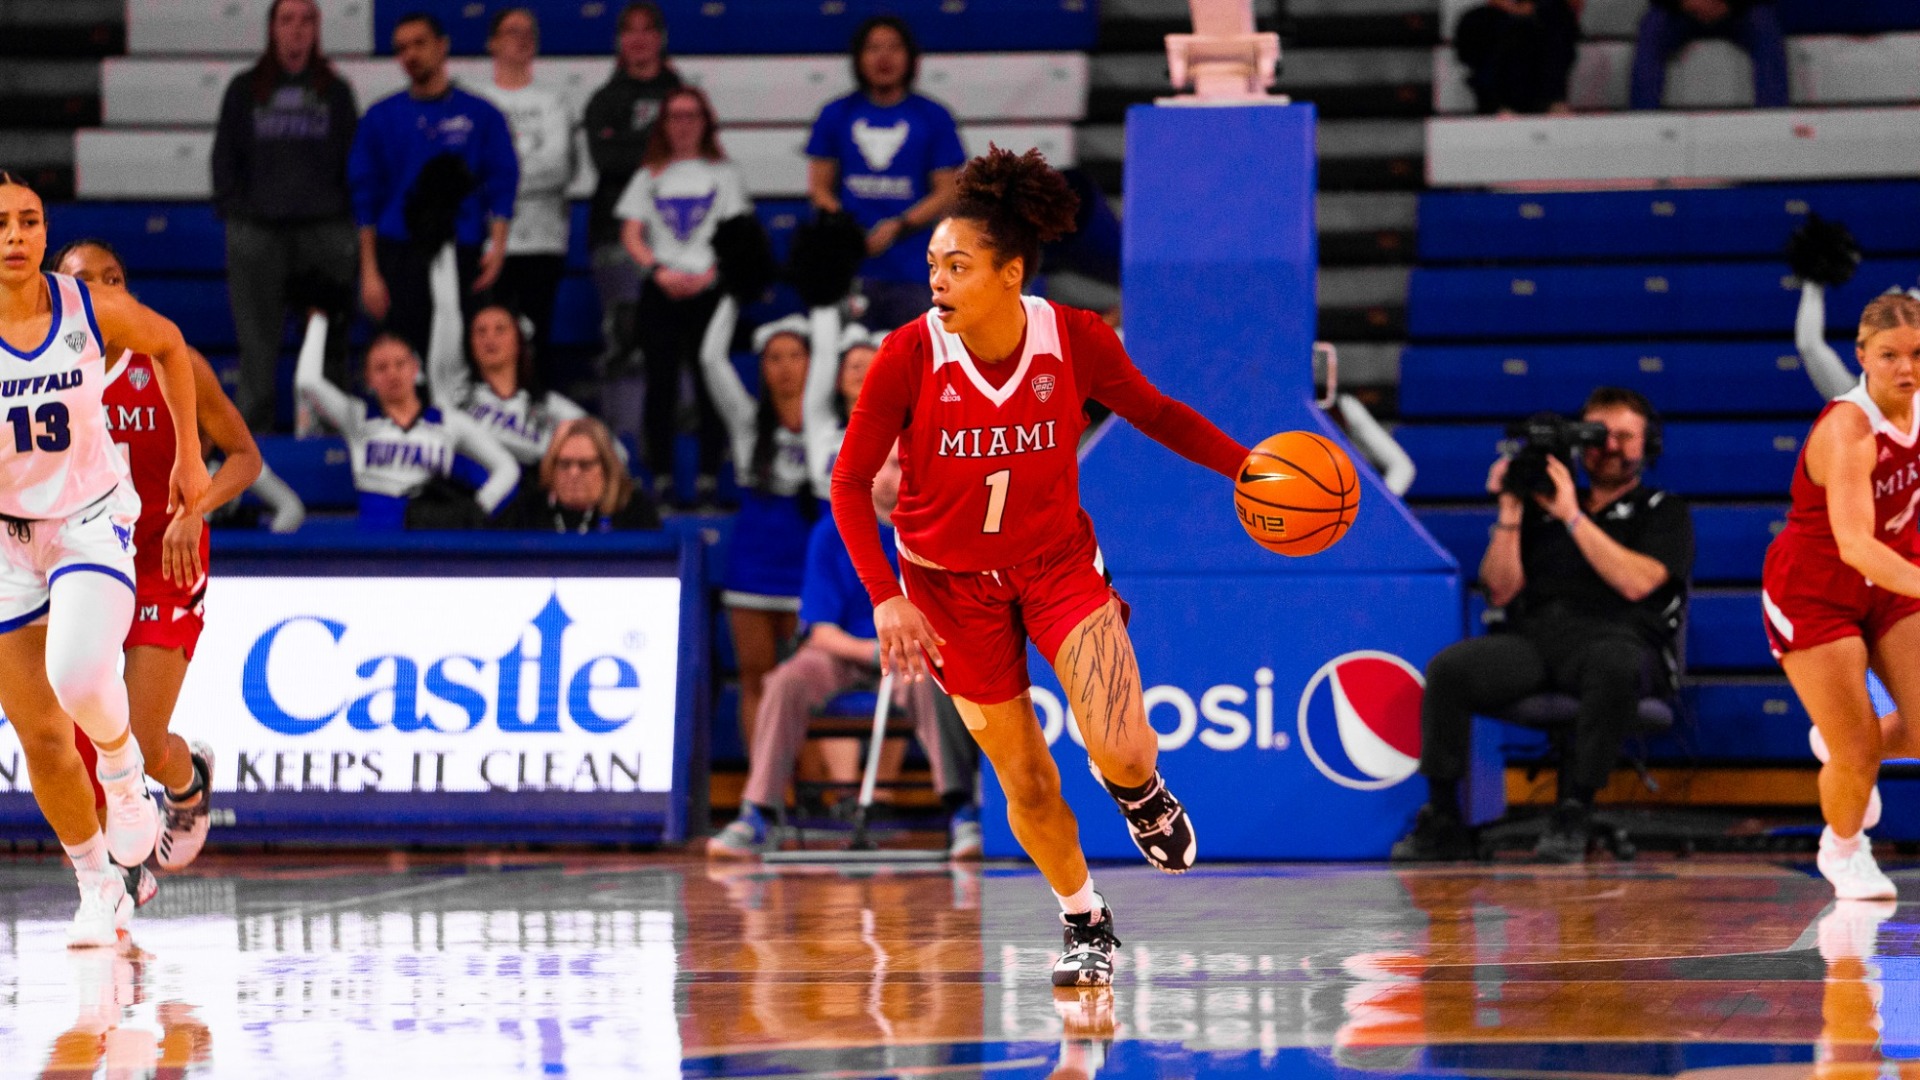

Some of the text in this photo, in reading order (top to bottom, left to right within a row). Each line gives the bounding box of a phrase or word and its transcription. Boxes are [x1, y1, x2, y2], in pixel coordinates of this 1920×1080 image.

[0, 369, 83, 397] UFFALO
[6, 402, 71, 453] 13
[938, 420, 1056, 457] MIAMI
[982, 469, 1010, 533] 1
[139, 604, 159, 622] M
[241, 582, 640, 736] Castle
[237, 749, 641, 791] KEEPS IT CLEAN
